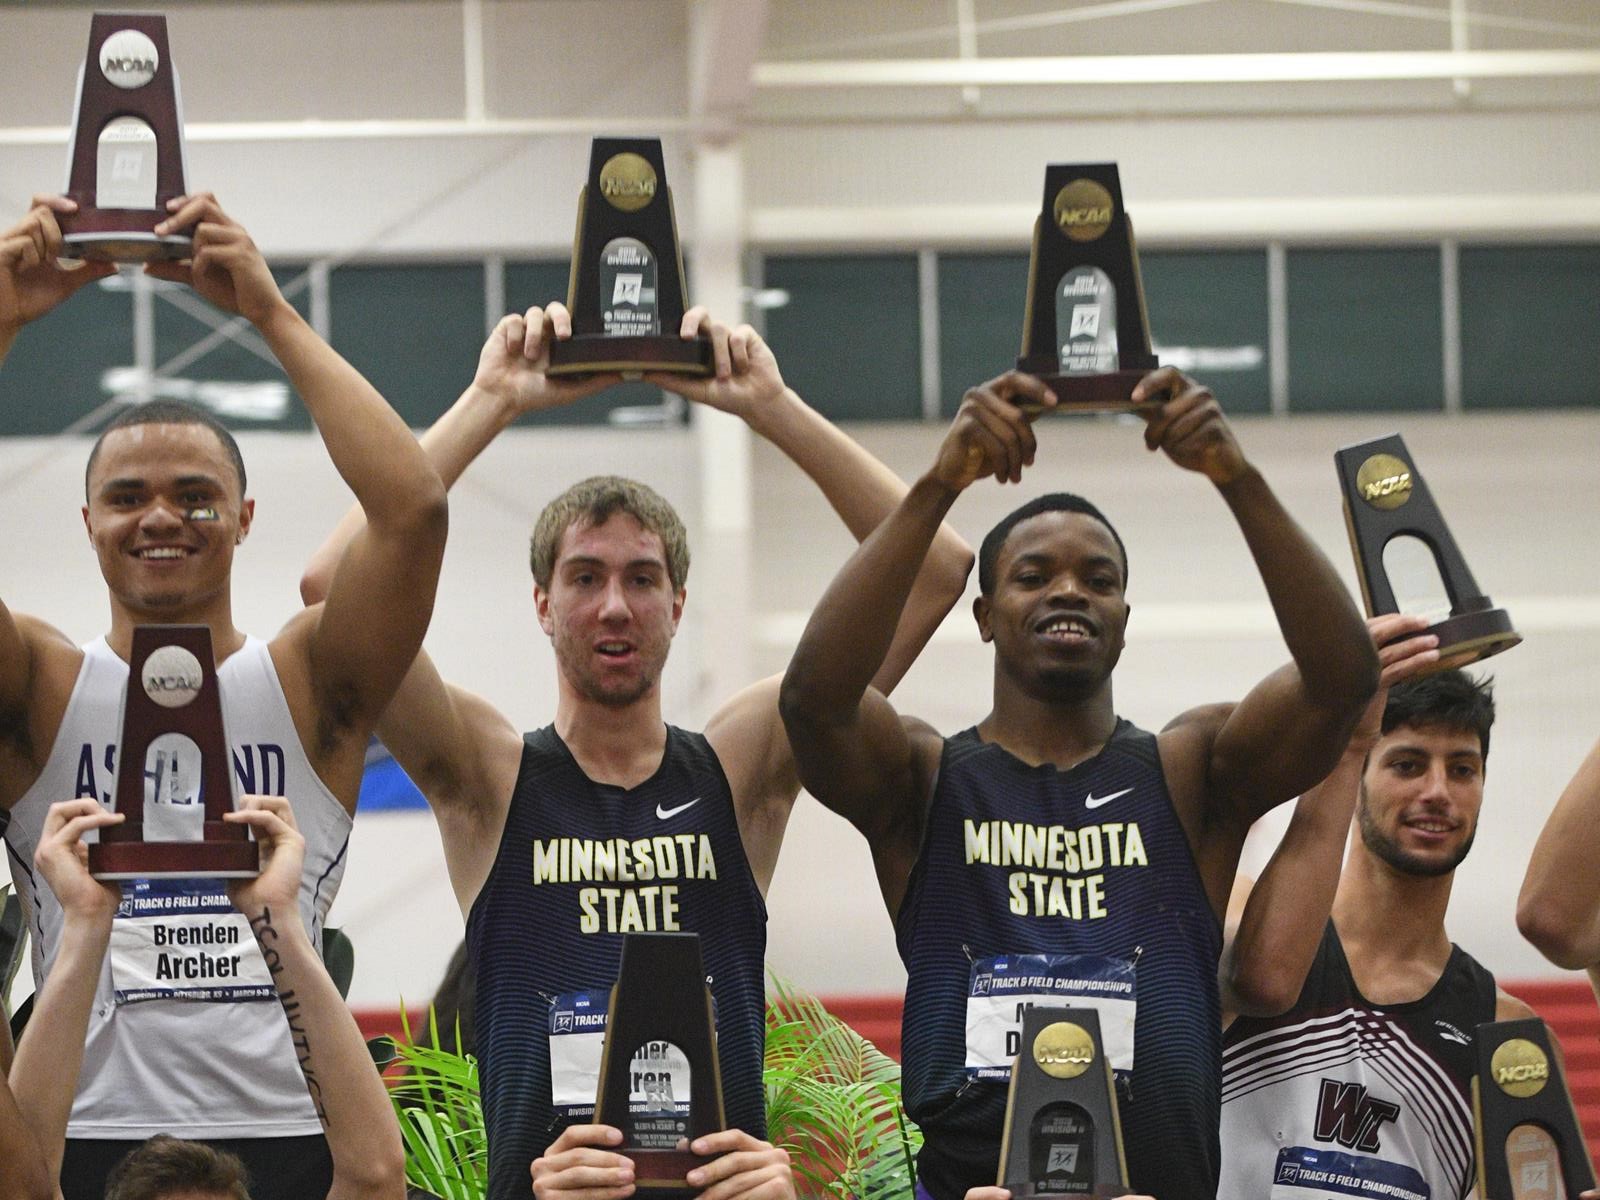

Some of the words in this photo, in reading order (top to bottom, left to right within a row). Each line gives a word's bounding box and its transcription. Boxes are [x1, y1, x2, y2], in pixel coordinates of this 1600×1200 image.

[1060, 207, 1110, 225] NCAA
[147, 677, 200, 692] NCAA
[963, 819, 1149, 873] MINNESOTA
[533, 834, 718, 886] MINNESOTA
[134, 898, 165, 910] TRACK
[173, 896, 199, 908] FIELD
[1008, 872, 1108, 920] STATE
[578, 885, 681, 934] STATE
[153, 922, 239, 946] Brenden
[156, 952, 241, 980] Archer
[991, 977, 1021, 989] TRACK
[1028, 976, 1053, 988] FIELD
[1054, 978, 1132, 993] CHAMPIONSHIPS
[574, 1014, 605, 1026] TRACK
[1498, 1064, 1549, 1084] NCAA
[1313, 1078, 1400, 1154] WT
[1298, 1169, 1328, 1182] TRACK
[1328, 1174, 1335, 1183] &
[1335, 1175, 1360, 1188] FIELD
